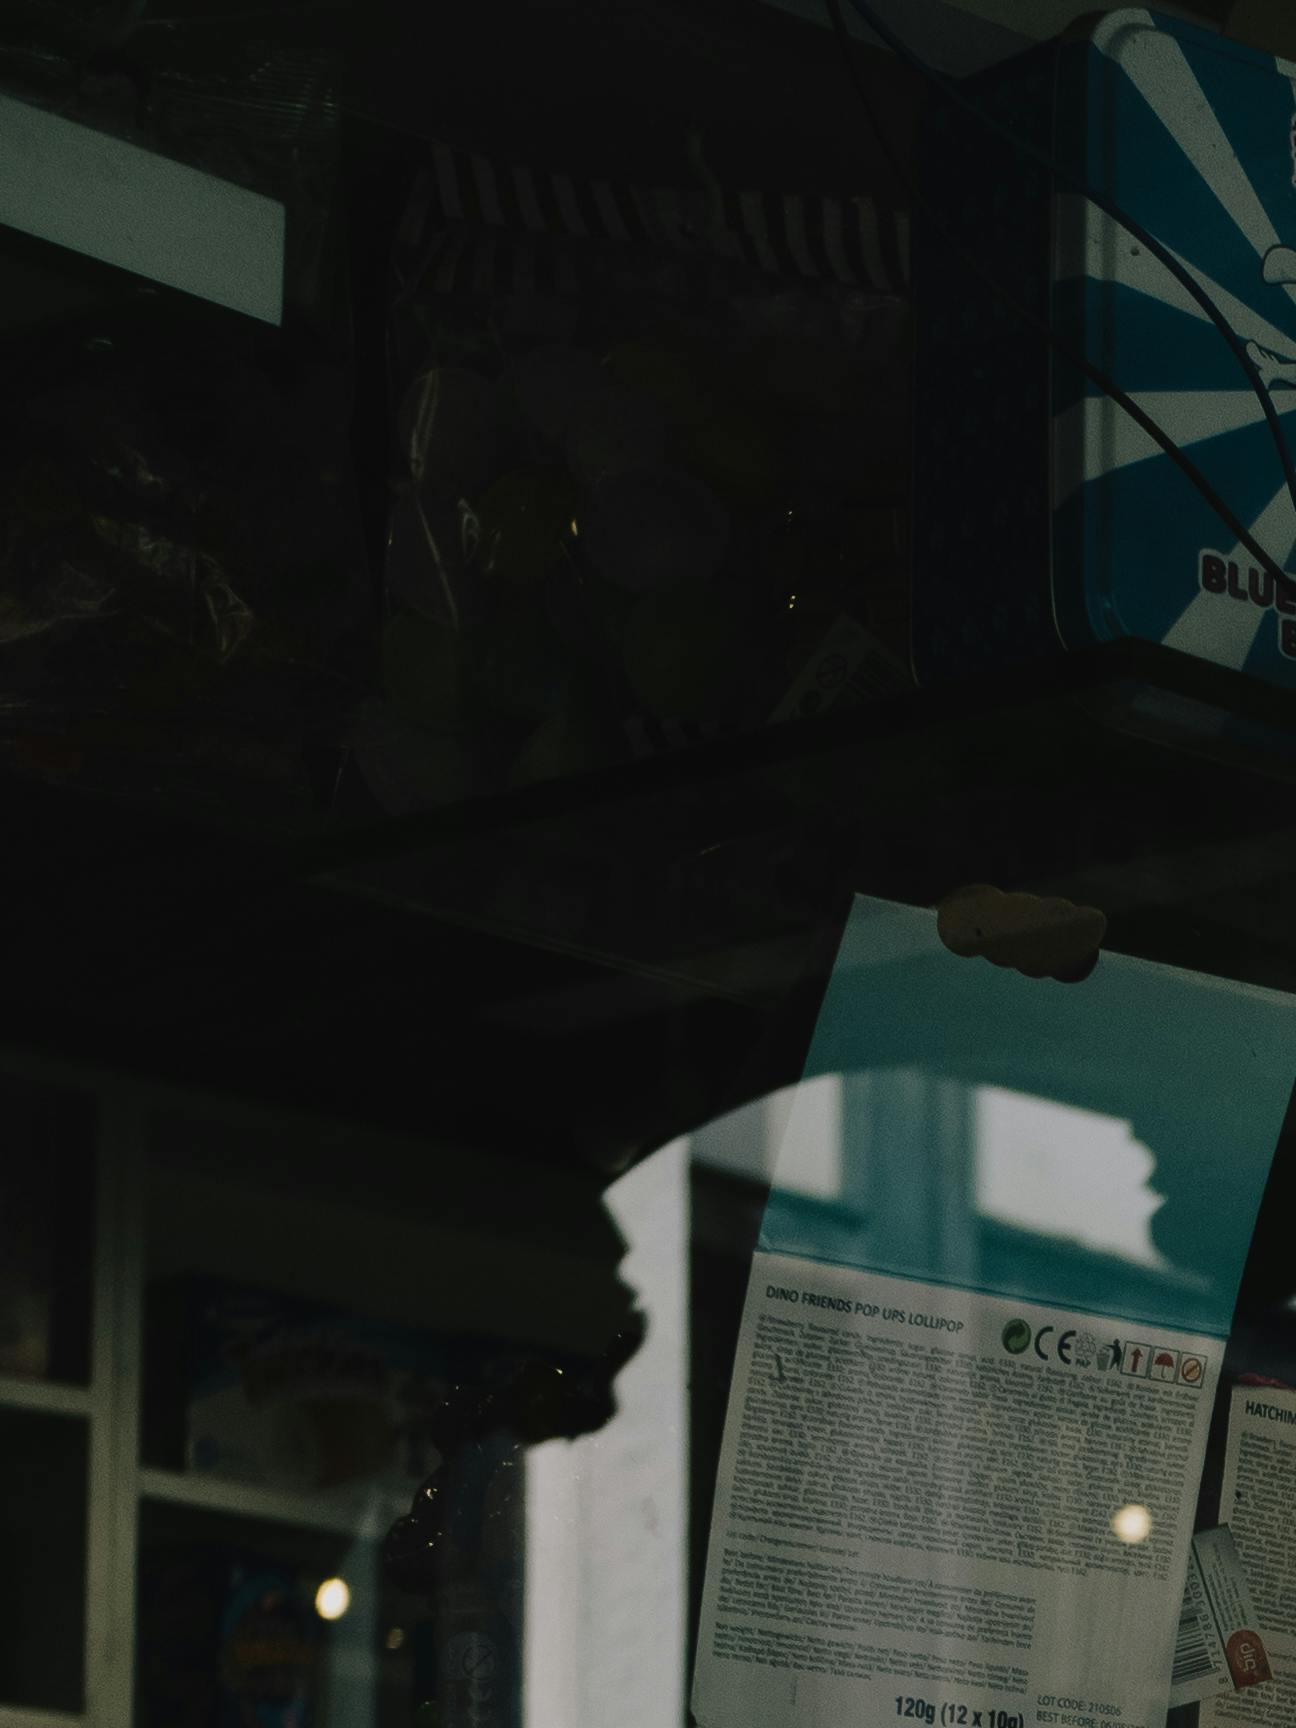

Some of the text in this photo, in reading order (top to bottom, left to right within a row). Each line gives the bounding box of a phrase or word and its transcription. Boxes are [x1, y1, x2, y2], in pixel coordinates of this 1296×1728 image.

[765, 1285, 964, 1334] DINO FRIENDS POP UPS LOLLIPOP
[894, 1695, 936, 1725] 120g
[941, 1700, 968, 1728] (12
[971, 1710, 983, 1727] x
[1037, 1693, 1086, 1712] LOT CODE:
[1036, 1710, 1060, 1724] BEST
